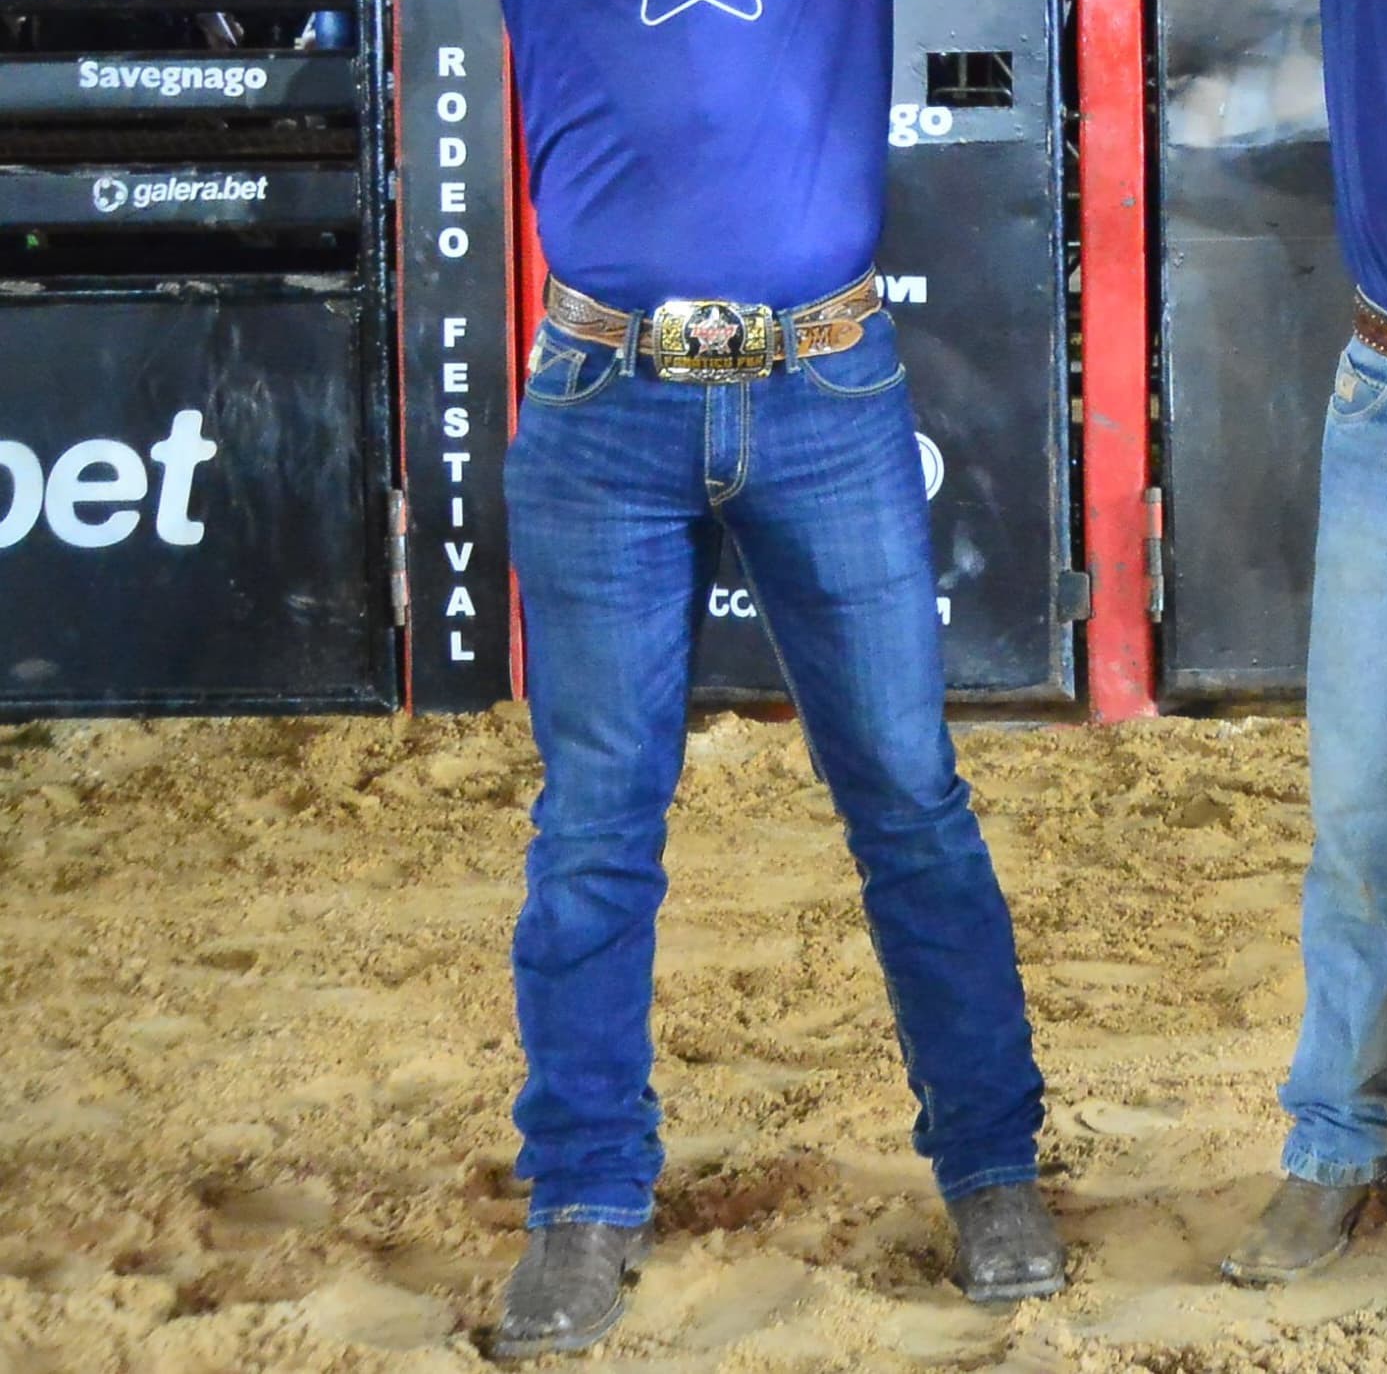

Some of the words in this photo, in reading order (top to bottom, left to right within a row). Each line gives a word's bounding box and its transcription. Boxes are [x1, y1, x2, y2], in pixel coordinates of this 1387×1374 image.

[79, 61, 268, 97] Savegnago
[133, 176, 268, 208] galera.bet
[437, 46, 469, 258] RODEO
[443, 316, 475, 662] FESTIVAL
